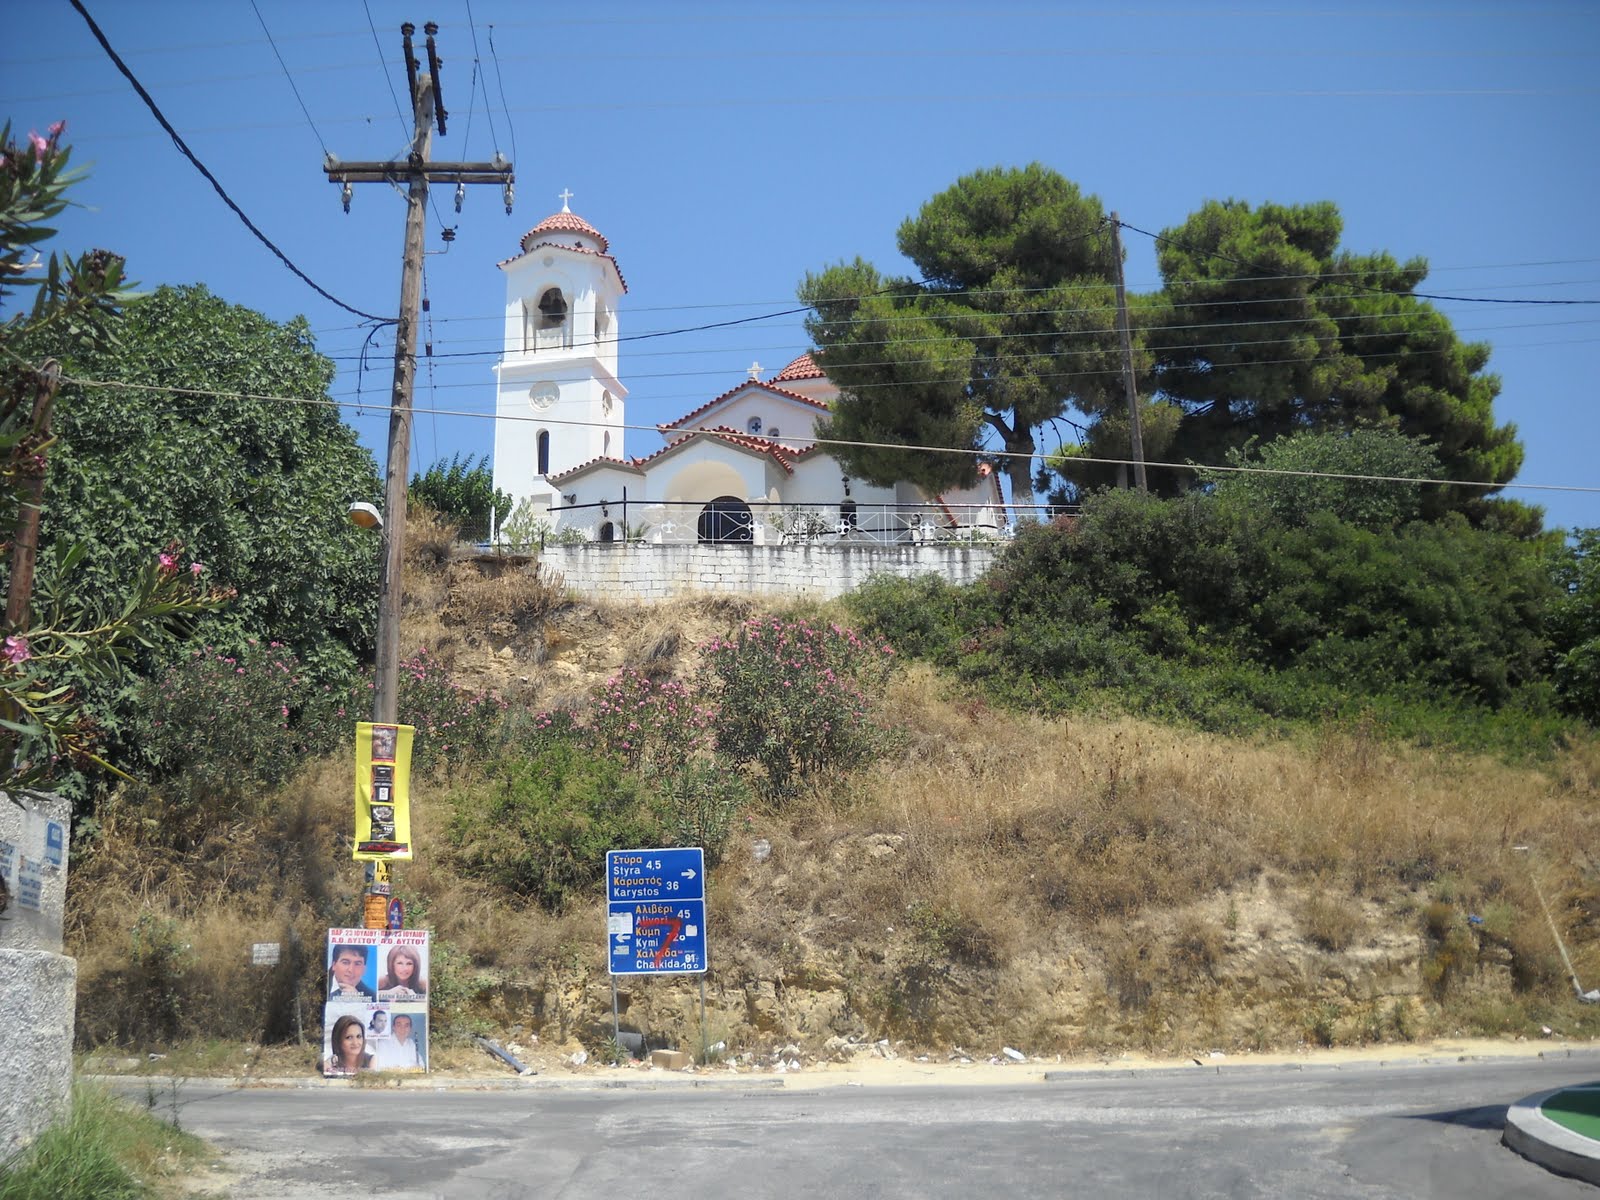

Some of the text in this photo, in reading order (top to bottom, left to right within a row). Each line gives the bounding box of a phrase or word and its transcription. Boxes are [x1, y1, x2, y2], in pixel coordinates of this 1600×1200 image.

[613, 855, 642, 865] Στύρα
[613, 866, 640, 877] Styra
[613, 876, 662, 886] Κάρυστός
[666, 881, 679, 890] 36
[613, 887, 659, 898] Karystos
[635, 904, 673, 915] Αλιβέρι
[677, 909, 691, 919] 45
[635, 938, 658, 949] Kymi
[636, 959, 679, 969] Chalkida
